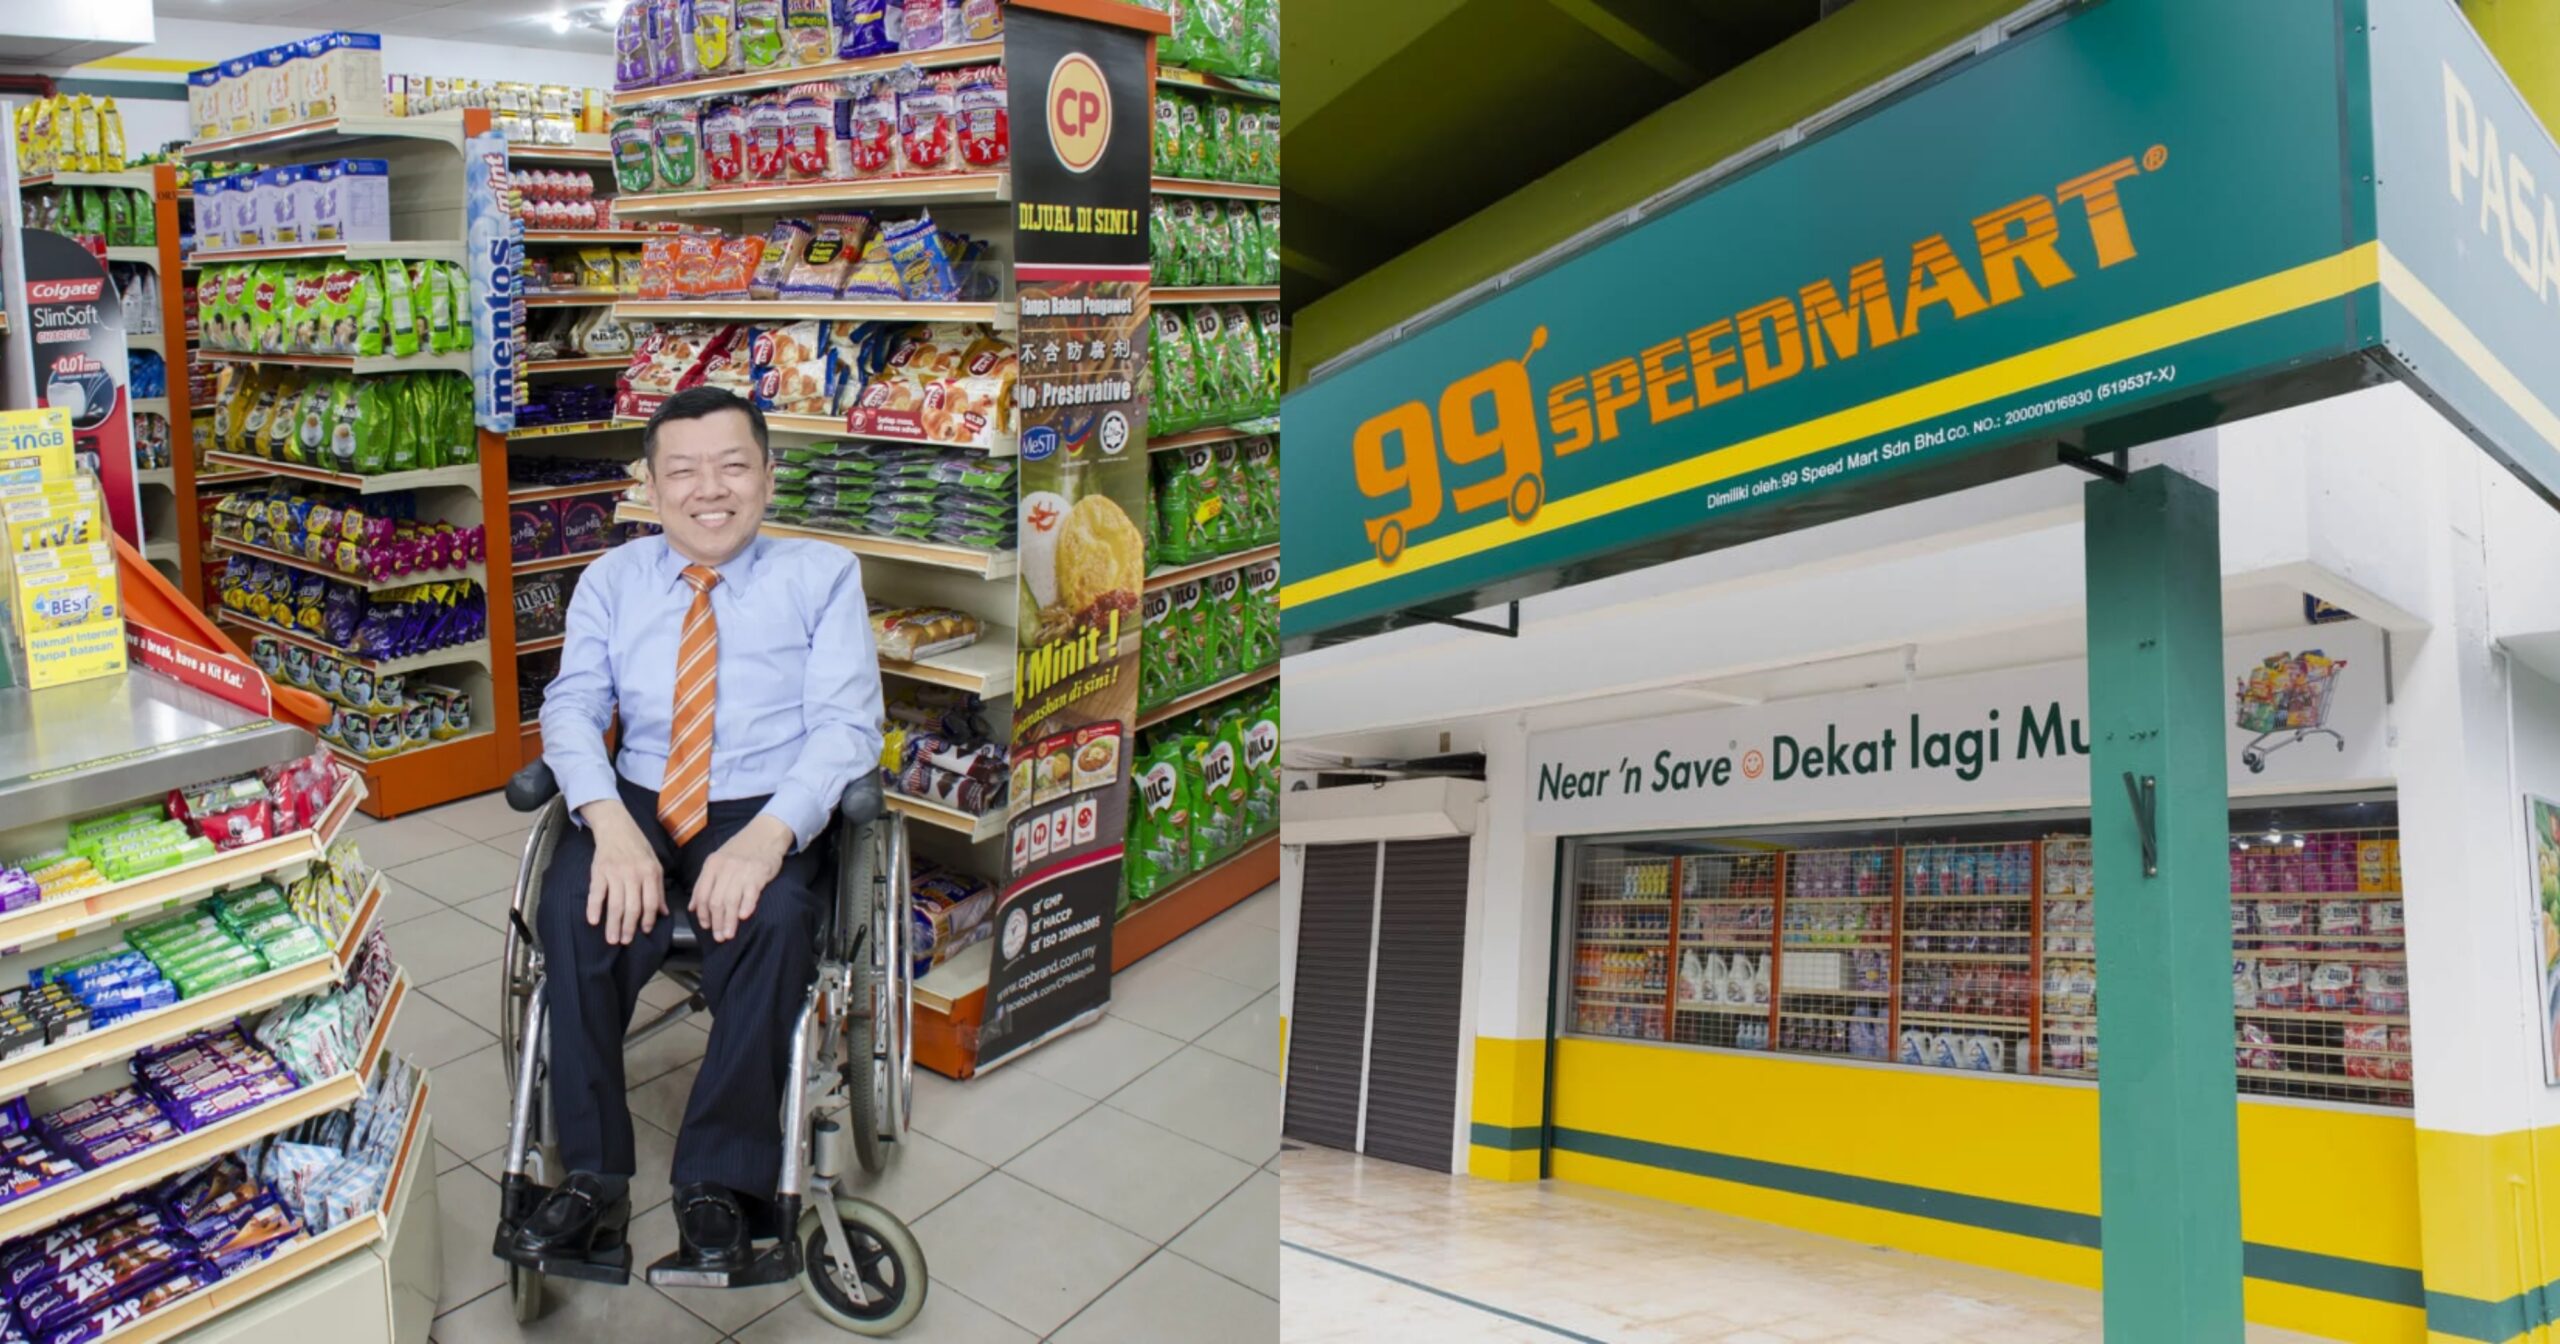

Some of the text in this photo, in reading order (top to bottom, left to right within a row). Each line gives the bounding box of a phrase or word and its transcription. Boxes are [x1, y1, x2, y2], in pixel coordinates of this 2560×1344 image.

[1056, 88, 1100, 137] CP
[484, 153, 510, 214] mint
[1019, 202, 1138, 235] DIJUAL DI SINI !
[32, 282, 98, 300] Colgate
[33, 304, 98, 328] SlimSoft
[1021, 296, 1132, 317] Tanpa Bahan Pengawet
[484, 238, 513, 417] mentos
[1353, 156, 2140, 560] 99 SPEEDMART
[1042, 378, 1132, 407] Preservative
[1024, 433, 1056, 454] MeSTI
[1707, 484, 1749, 509] Dimiliki
[1801, 458, 1843, 484] Speed
[1847, 448, 1878, 469] Mart
[1882, 440, 1911, 460] Sdn
[2005, 389, 2093, 426] 200001016930
[2096, 365, 2177, 401] (519537-X)
[51, 595, 92, 615] BEST
[1176, 586, 1197, 605] ILO
[31, 627, 118, 650] Nikmati Internet
[33, 642, 113, 663] Tanpa Batasan
[147, 639, 174, 663] break,
[175, 649, 197, 670] have
[207, 662, 222, 681] Kit
[1028, 625, 1100, 699] Minit
[1108, 608, 1119, 658] !
[1083, 668, 1110, 695] sini
[1537, 762, 1610, 802] Near
[1651, 750, 1731, 793] Save
[1773, 723, 1896, 781] Dekat
[1911, 709, 2000, 781] lagi
[1043, 908, 1073, 929] HACCP
[1043, 937, 1057, 949] ISO
[13, 1238, 98, 1284] Cadbury ZIP
[20, 1284, 52, 1309] Cadbury
[31, 1295, 64, 1320] Cadbury
[92, 1298, 141, 1335] ZIP
